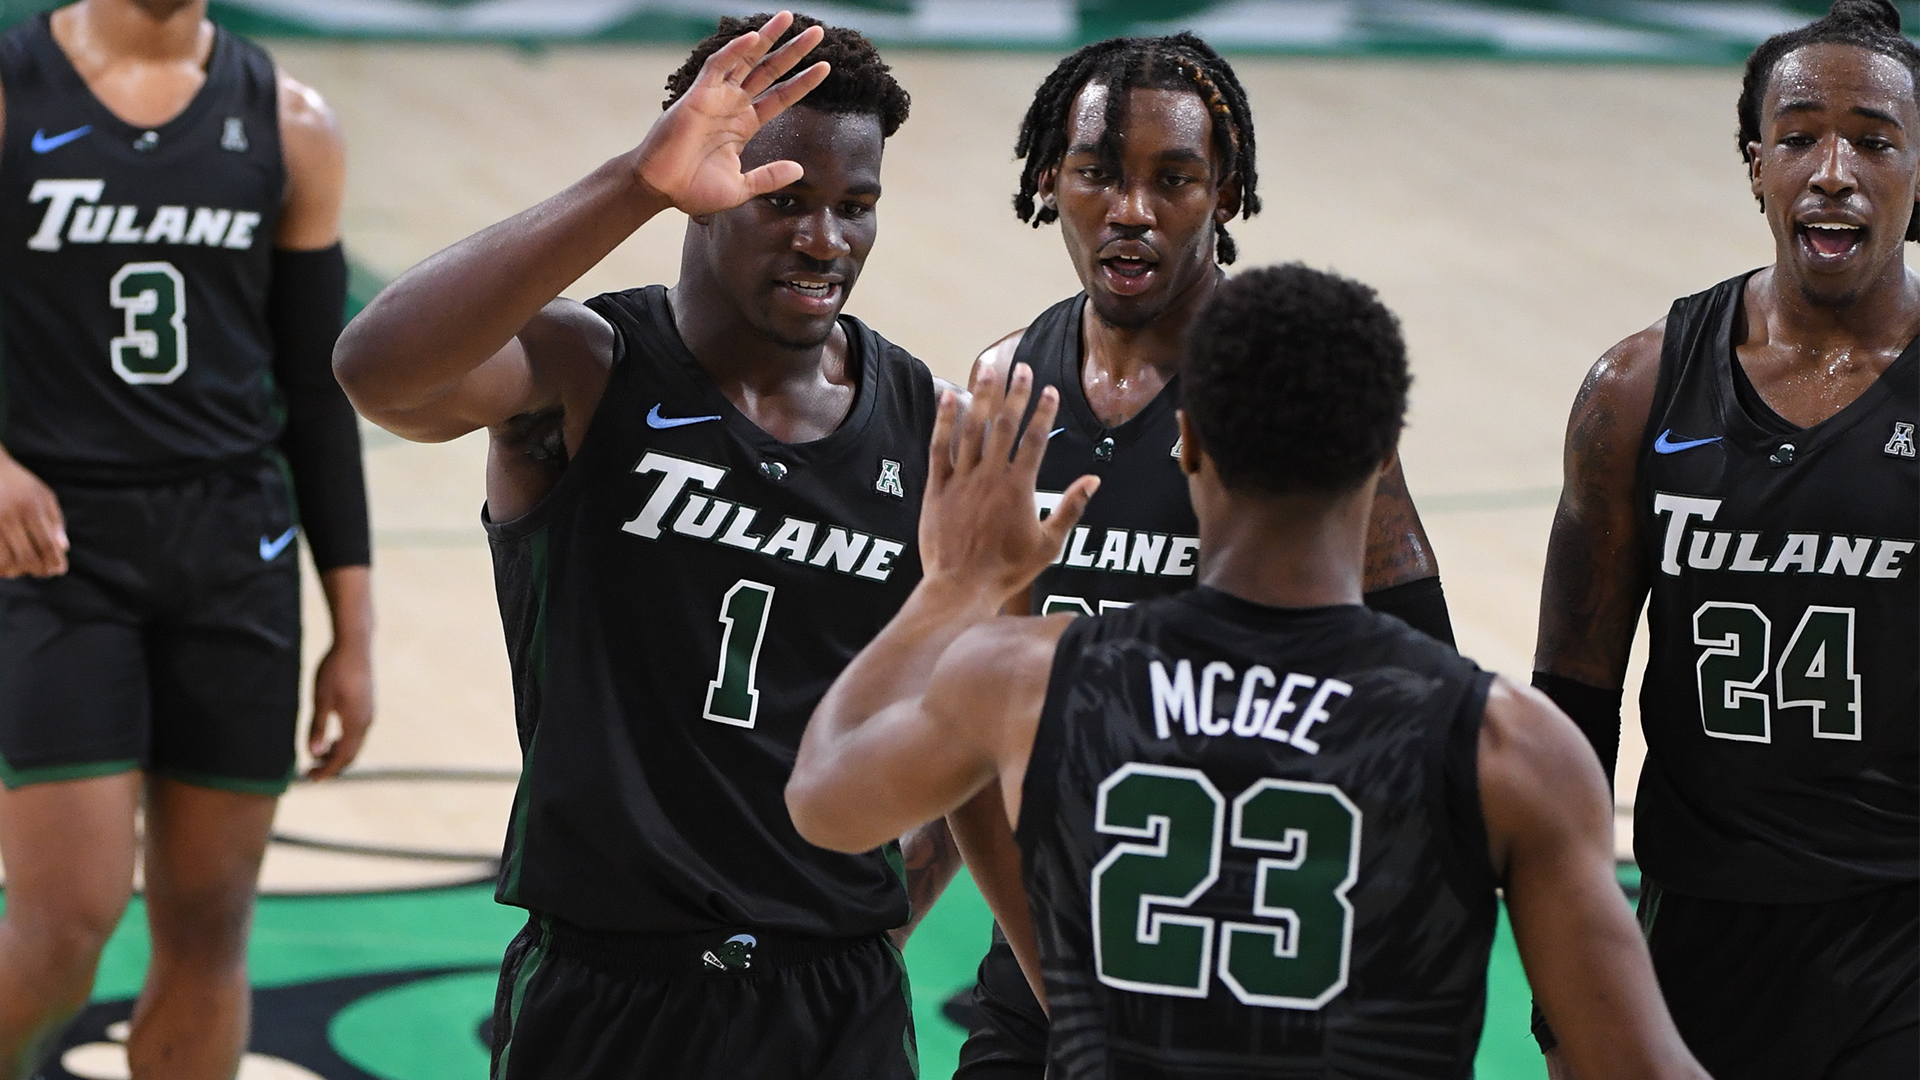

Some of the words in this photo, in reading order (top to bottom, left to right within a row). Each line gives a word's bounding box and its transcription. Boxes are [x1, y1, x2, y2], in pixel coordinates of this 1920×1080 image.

[28, 179, 261, 251] TULANE
[109, 261, 189, 384] 3
[622, 450, 905, 582] TULANE
[1034, 490, 1200, 577] LANE
[1653, 492, 1916, 579] TULANE
[702, 578, 776, 729] 1
[1149, 658, 1353, 756] MCGEE
[1692, 600, 1862, 744] 24
[1091, 761, 1363, 1011] 23
